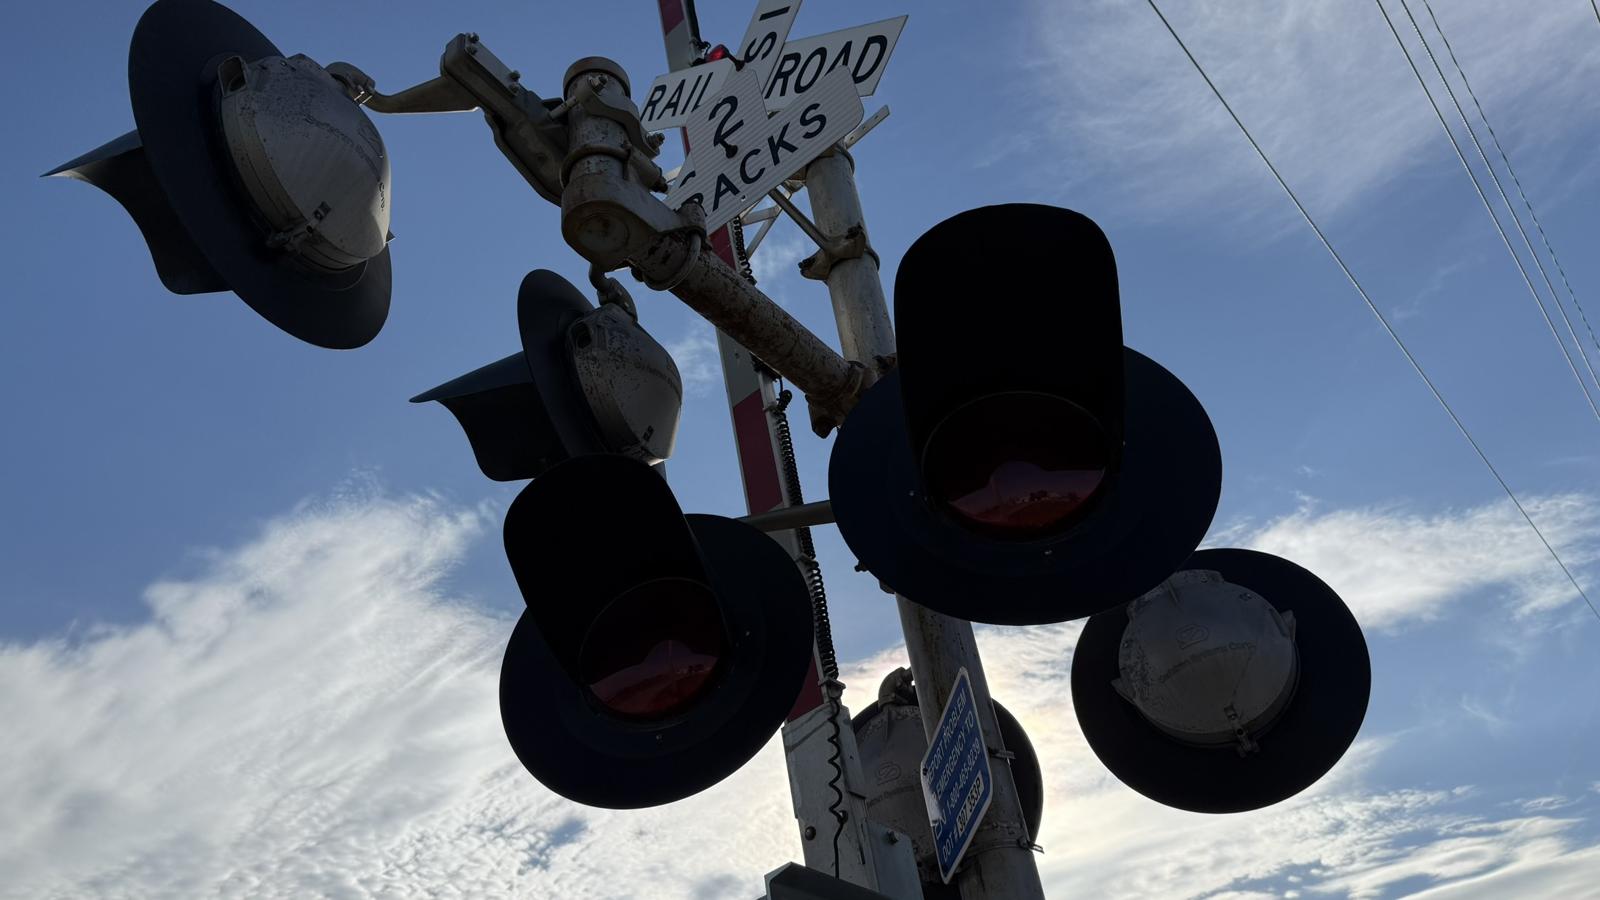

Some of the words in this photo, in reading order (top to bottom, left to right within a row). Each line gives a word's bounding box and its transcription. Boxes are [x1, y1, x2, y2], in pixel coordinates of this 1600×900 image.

[640, 72, 714, 121] RAIL
[764, 35, 888, 99] ROAD
[708, 95, 744, 148] 2
[936, 727, 966, 800] EMERGENCY
[965, 710, 974, 733] TO
